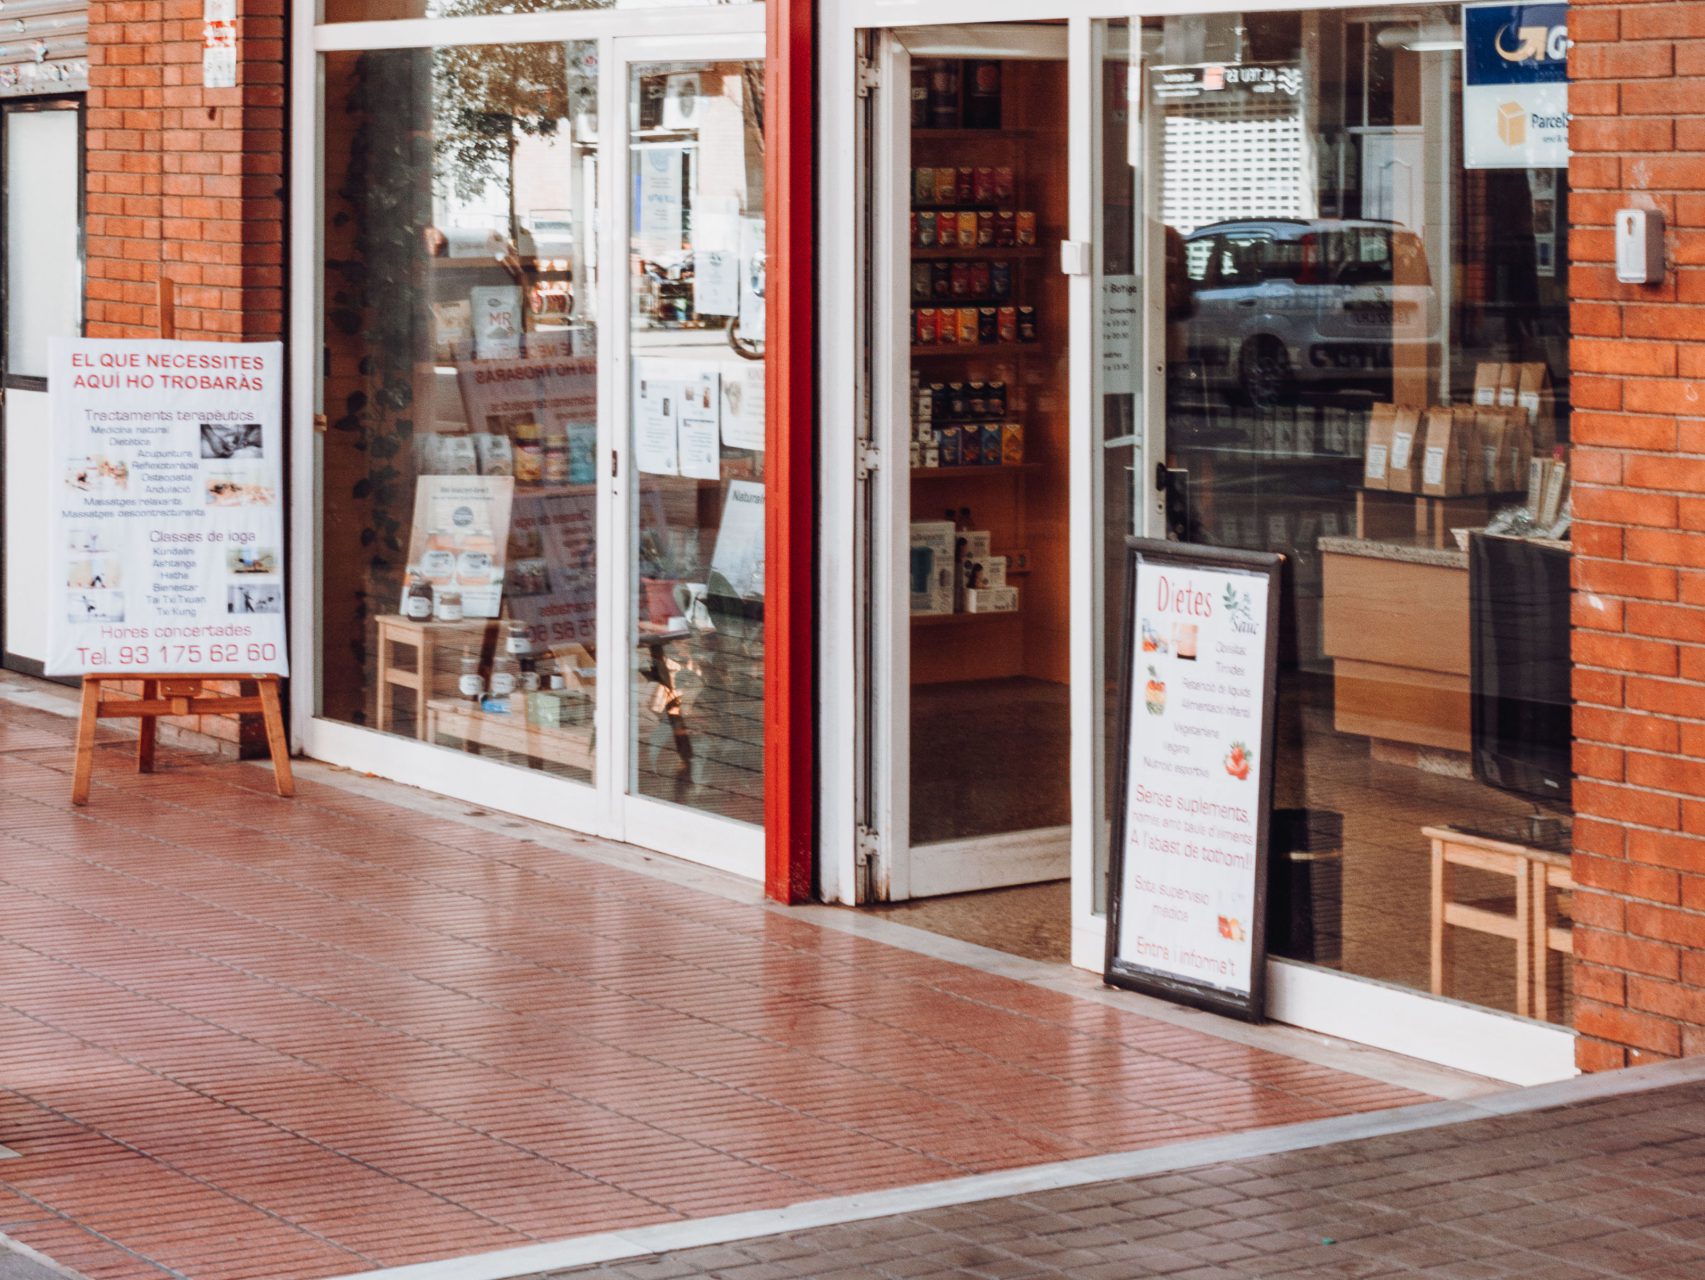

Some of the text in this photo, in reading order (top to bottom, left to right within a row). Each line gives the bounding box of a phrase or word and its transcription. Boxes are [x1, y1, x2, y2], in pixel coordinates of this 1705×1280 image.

[72, 353, 265, 370] EL QUE NECESSITES
[74, 372, 264, 391] AQUÍ HO TROBARÀS
[85, 409, 254, 423] Tractaments terapèutics
[136, 426, 169, 434] natural
[84, 498, 136, 508] Massatges
[62, 510, 114, 519] Massatges
[150, 530, 256, 544] Classes de ioga
[1156, 575, 1213, 618] Dietes
[101, 623, 252, 639] Hores concertades
[77, 642, 277, 666] Tel. 93 175 62 60
[1136, 783, 1173, 809] Sense
[1184, 838, 1200, 860] de
[1136, 935, 1170, 962] Entra
